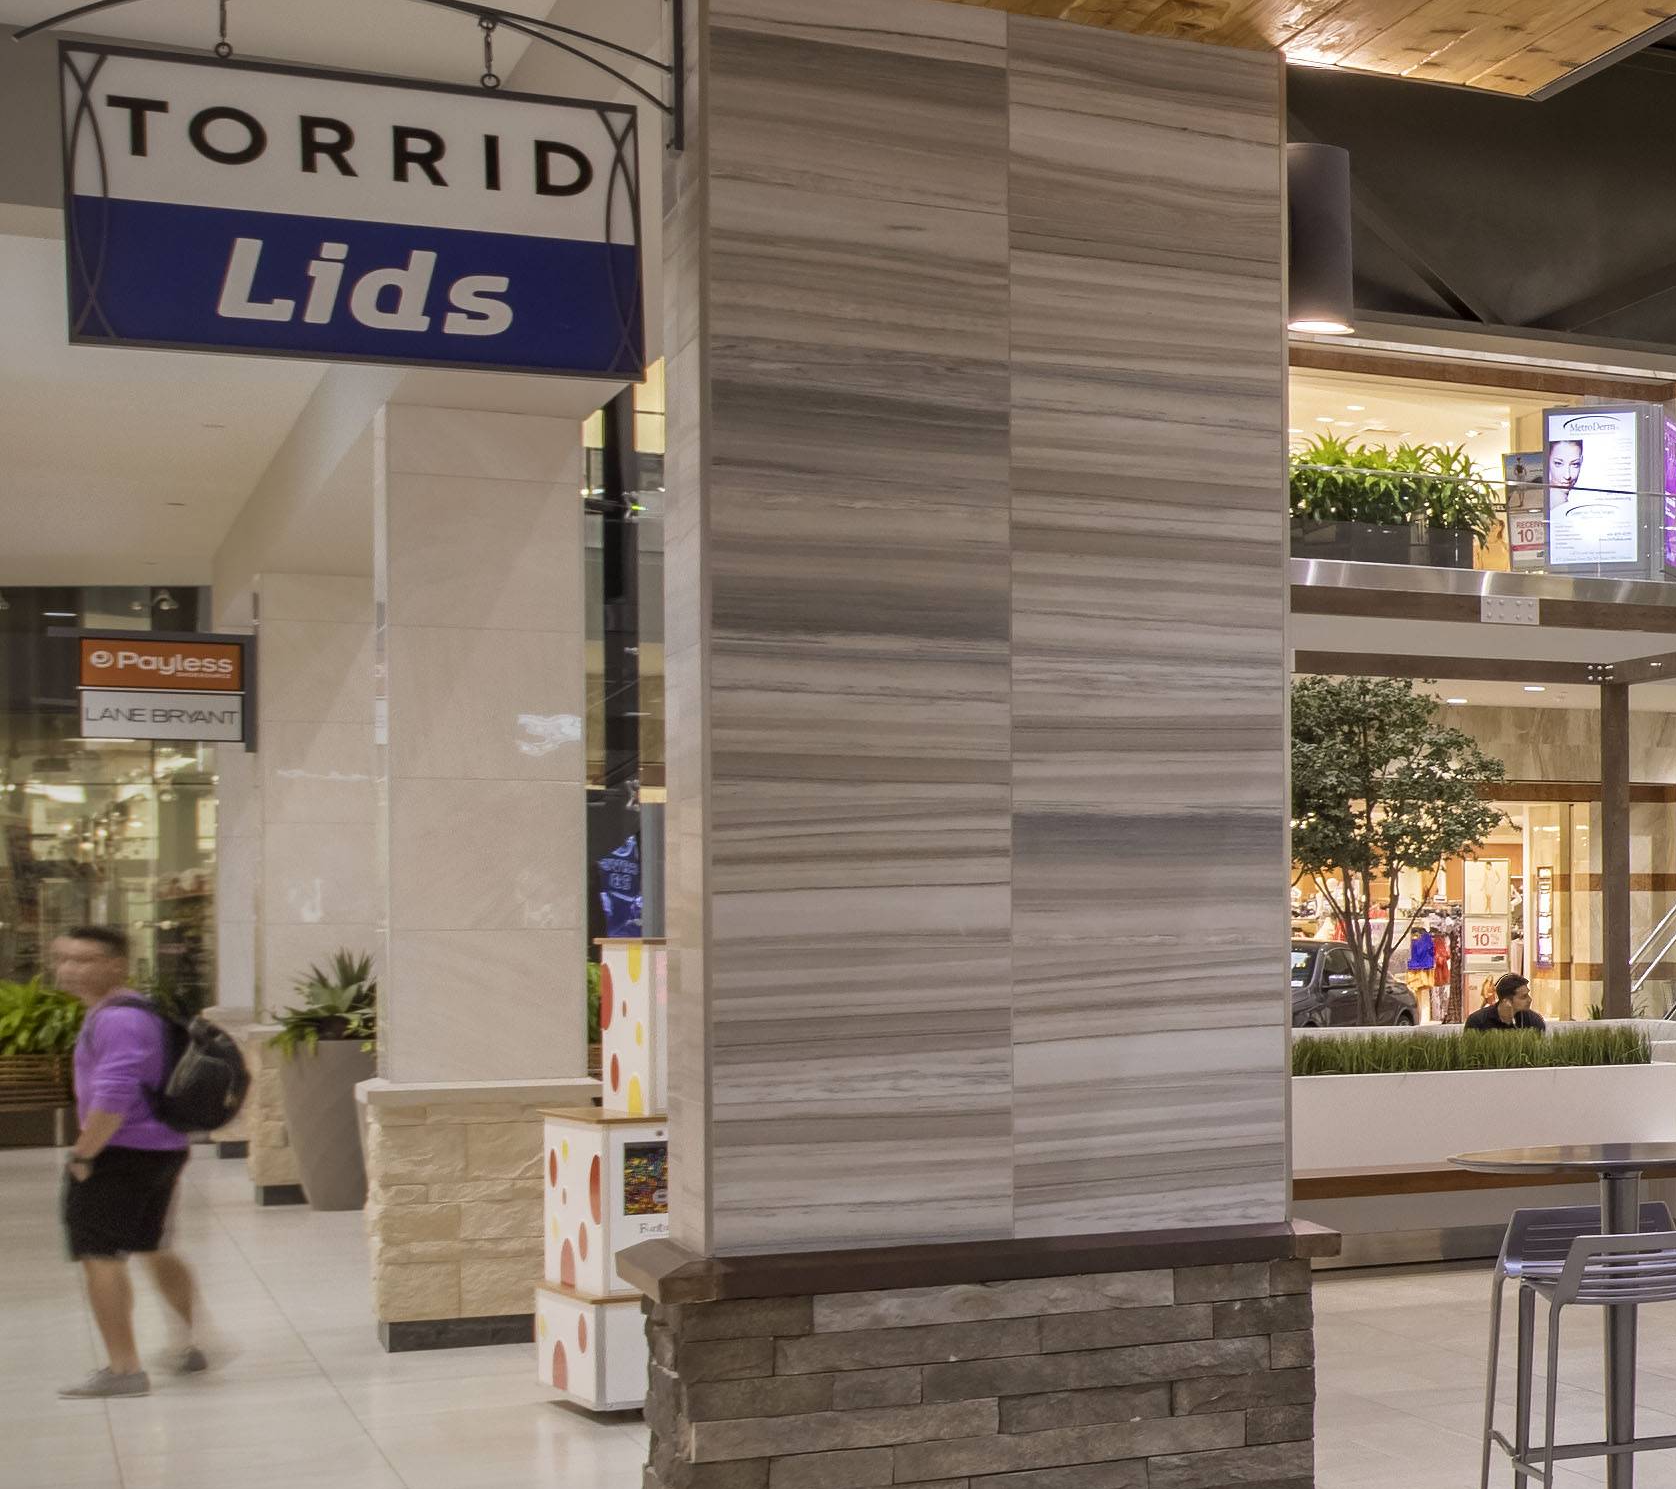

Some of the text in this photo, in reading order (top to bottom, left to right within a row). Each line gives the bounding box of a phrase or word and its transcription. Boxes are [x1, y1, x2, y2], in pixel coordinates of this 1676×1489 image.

[106, 94, 594, 198] TORRID
[215, 236, 515, 337] Lids
[1569, 421, 1616, 433] MetroDerm
[117, 650, 233, 676] Payless
[85, 707, 239, 725] LANE BRYANT
